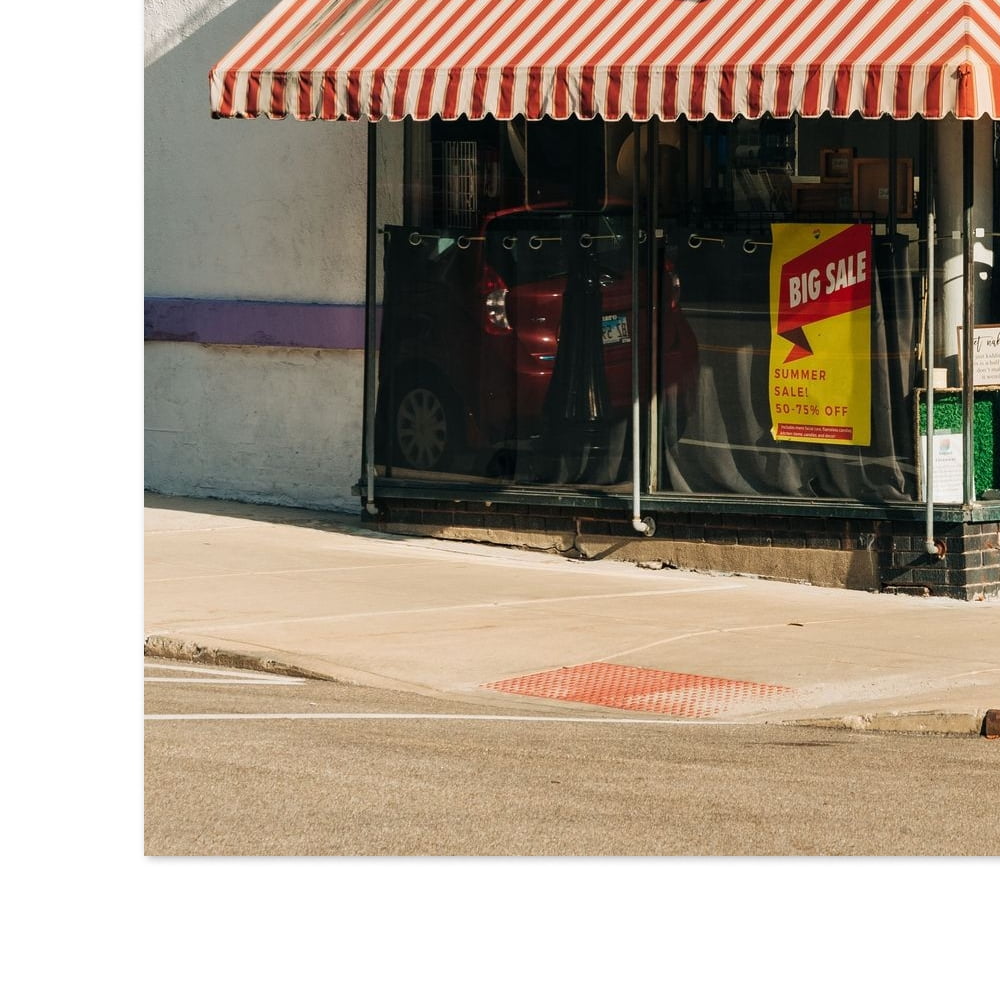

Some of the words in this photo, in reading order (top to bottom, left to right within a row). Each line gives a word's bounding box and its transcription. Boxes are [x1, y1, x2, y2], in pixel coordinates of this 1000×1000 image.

[789, 268, 821, 309] BIG
[825, 250, 866, 295] SALE
[774, 368, 826, 381] SUMMER
[774, 386, 808, 398] SALE!
[775, 403, 820, 416] 50-75%
[824, 405, 849, 417] OFF
